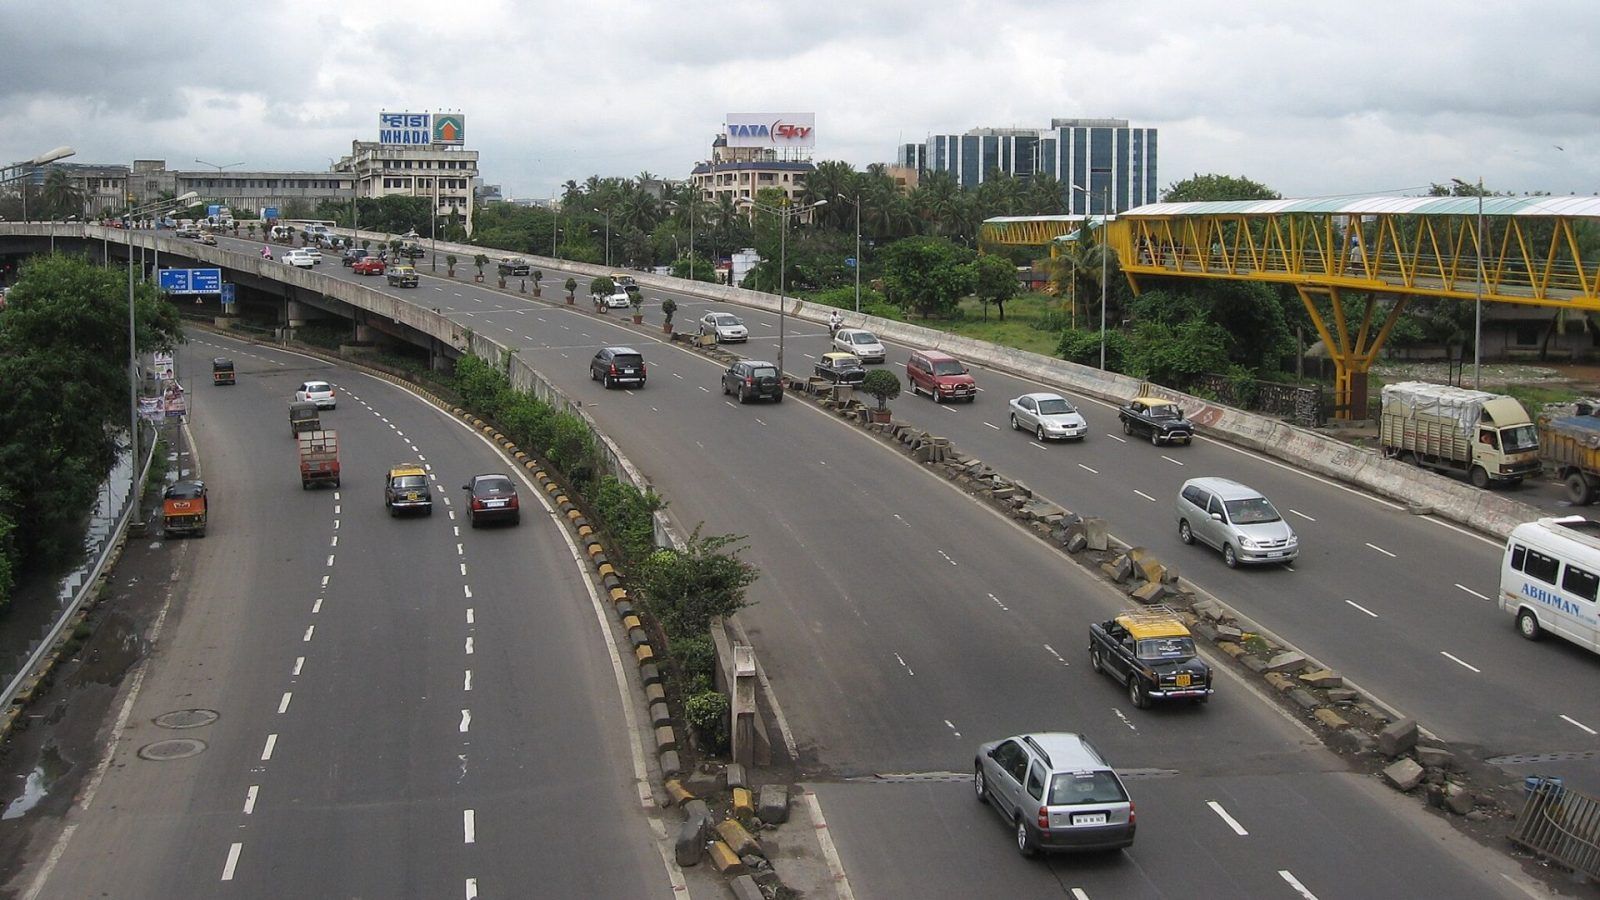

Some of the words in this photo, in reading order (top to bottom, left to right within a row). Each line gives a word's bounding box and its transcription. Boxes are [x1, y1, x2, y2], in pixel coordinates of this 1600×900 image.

[380, 114, 430, 128] म्हाडा
[380, 130, 430, 144] MHADA
[728, 125, 769, 137] TATA
[775, 125, 811, 139] Sky
[1521, 583, 1580, 617] ABHIMAN
